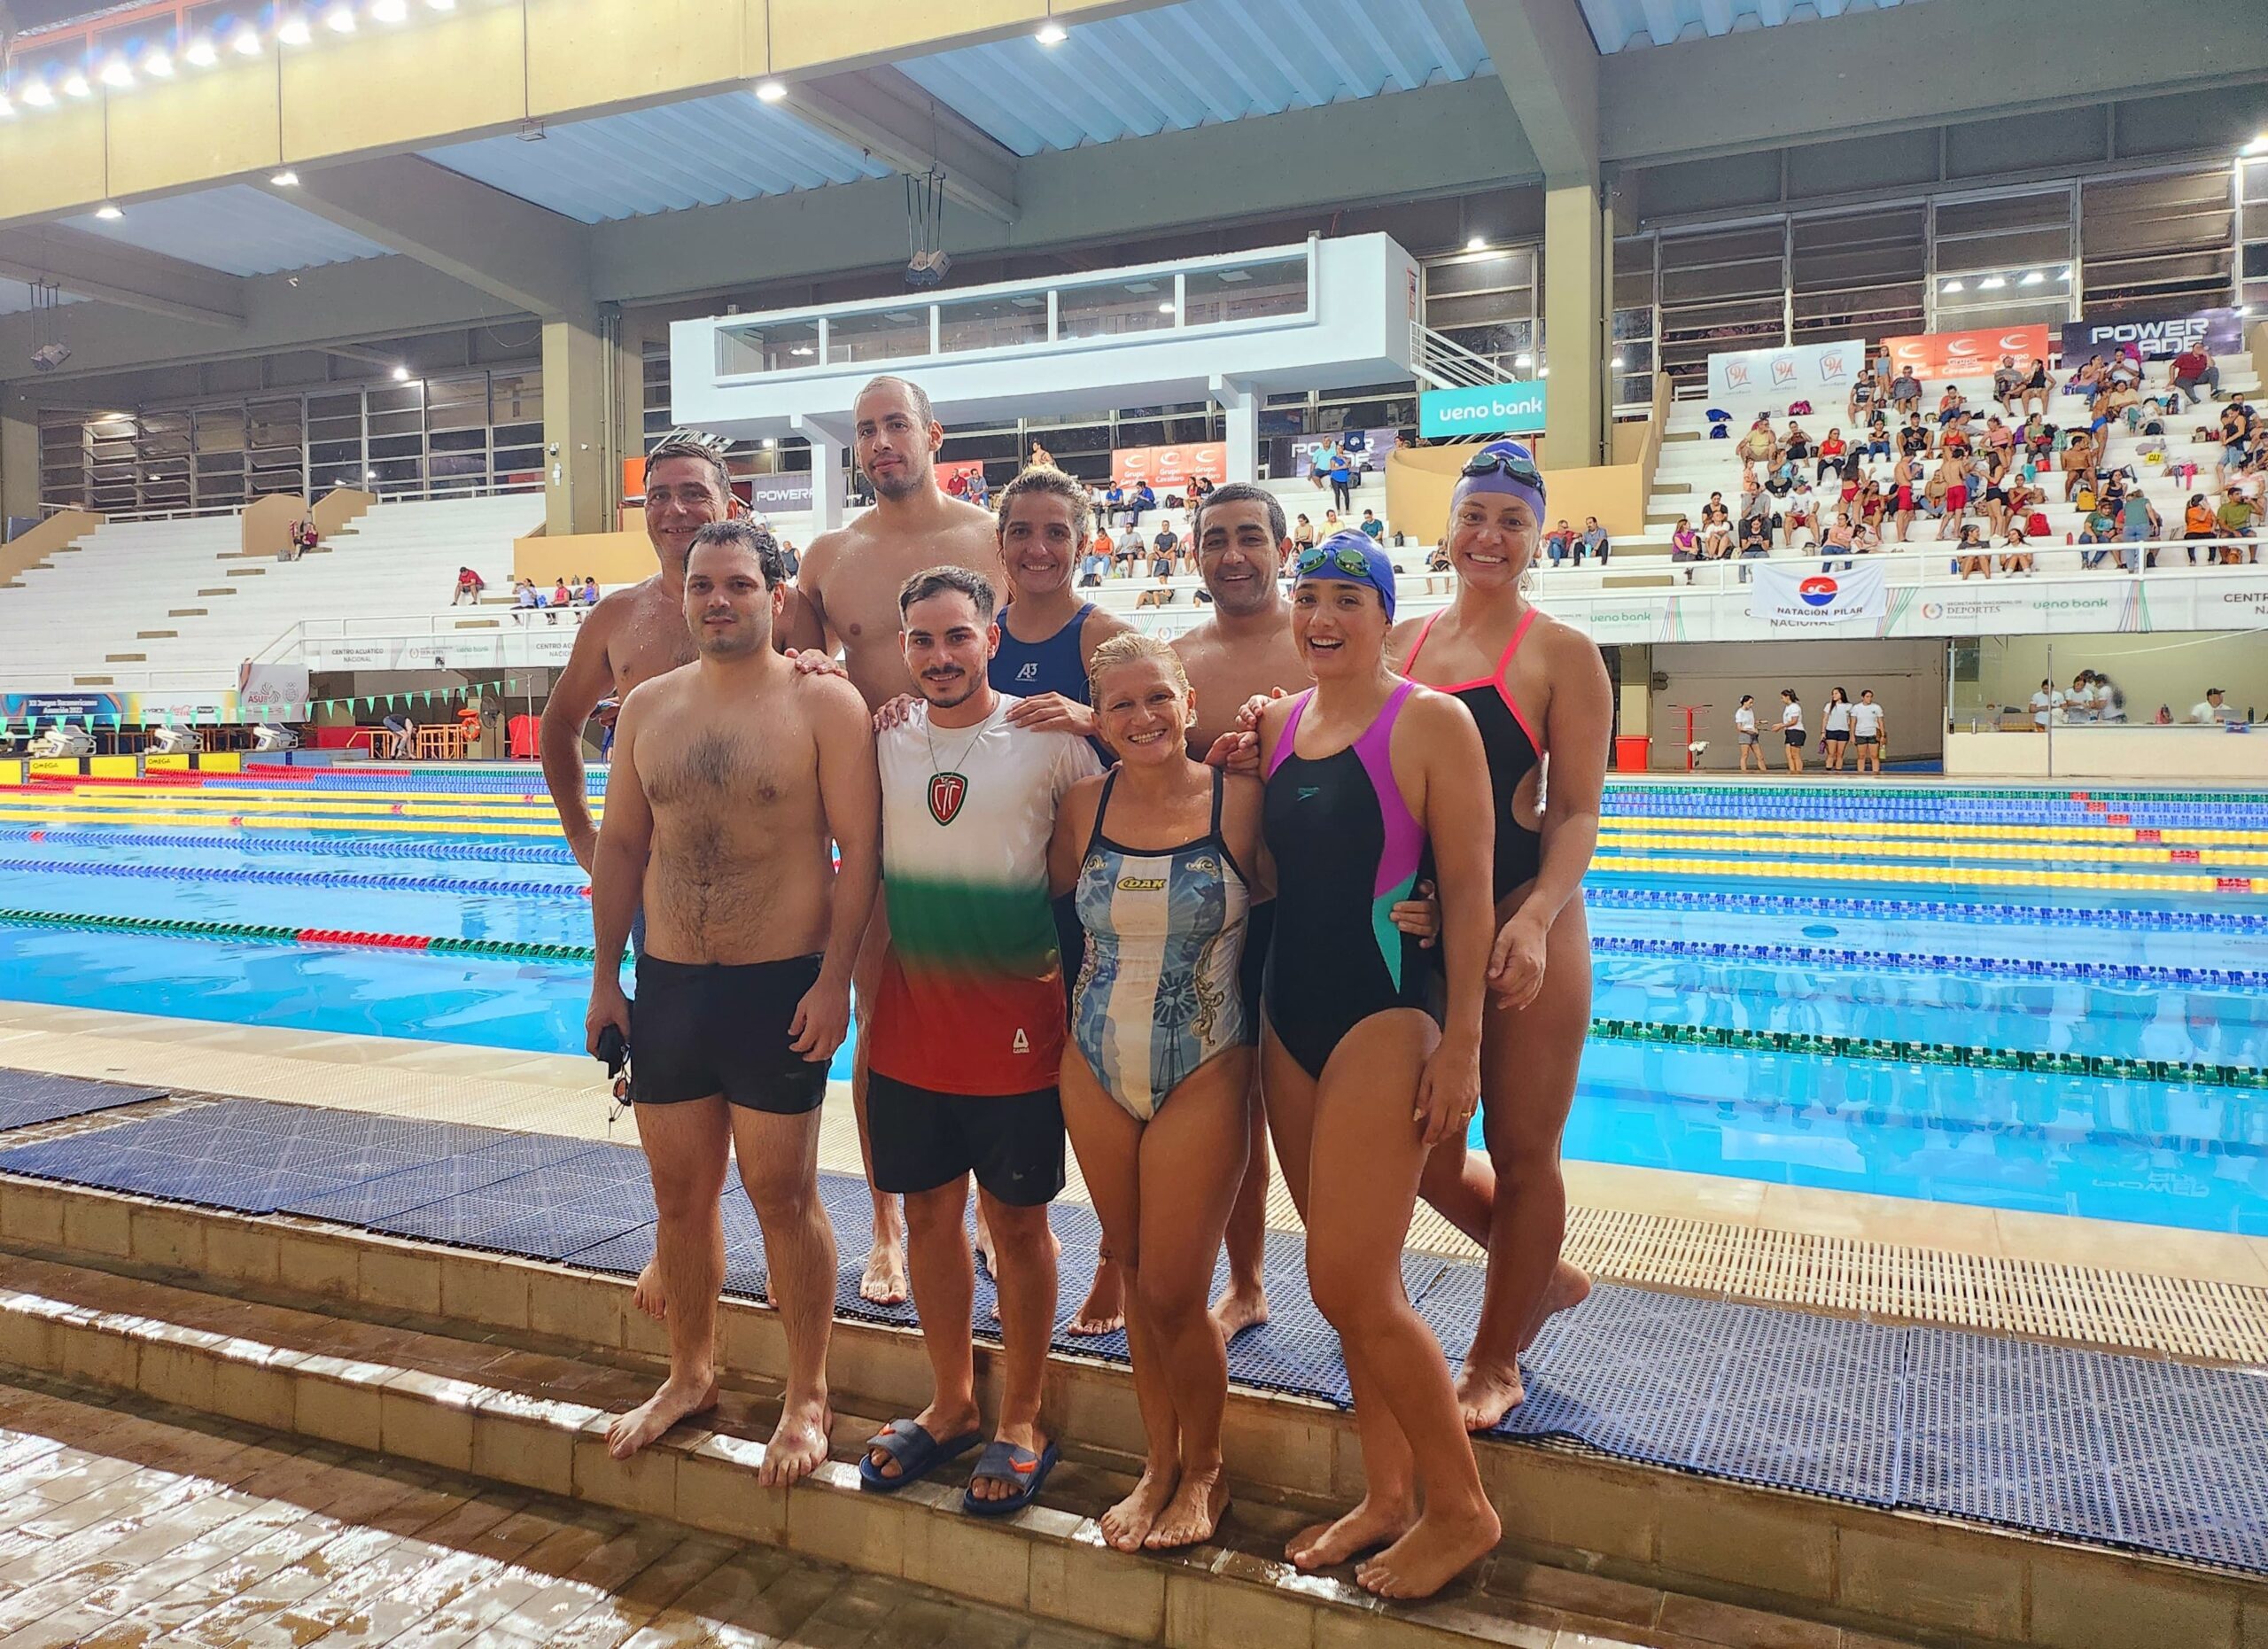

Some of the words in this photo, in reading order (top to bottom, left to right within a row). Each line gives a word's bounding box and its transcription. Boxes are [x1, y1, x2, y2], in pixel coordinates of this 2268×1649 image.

[2091, 317, 2210, 345] POWER
[2138, 335, 2204, 355] ADE
[1440, 405, 1489, 421] ueno
[1492, 396, 1542, 416] bank
[1123, 471, 1146, 479] Grupo
[1160, 468, 1182, 477] Grupo
[2033, 601, 2070, 610] ueno
[2072, 597, 2108, 609] bank
[1834, 607, 1863, 616] PILAR
[1947, 605, 2001, 614] DEPORTES
[1621, 611, 1651, 621] bank
